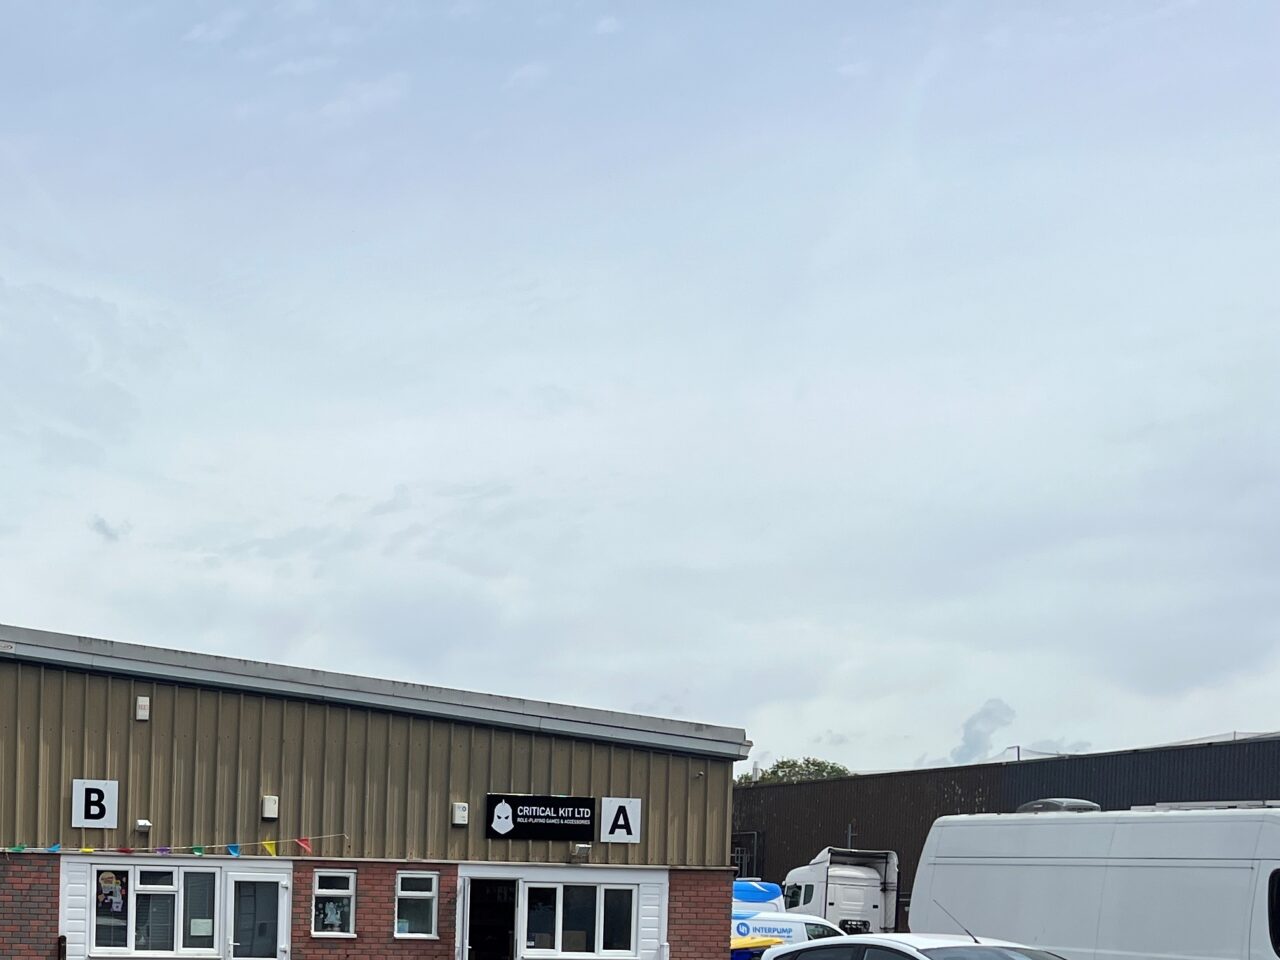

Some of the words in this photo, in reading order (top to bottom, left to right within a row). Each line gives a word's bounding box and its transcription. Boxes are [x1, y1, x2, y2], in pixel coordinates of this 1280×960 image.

[84, 788, 106, 820] B
[517, 806, 557, 817] CRITICAL
[559, 807, 572, 818] KIT
[574, 808, 591, 818] LTD
[608, 805, 633, 836] A
[753, 926, 793, 934] INTERPUMP
